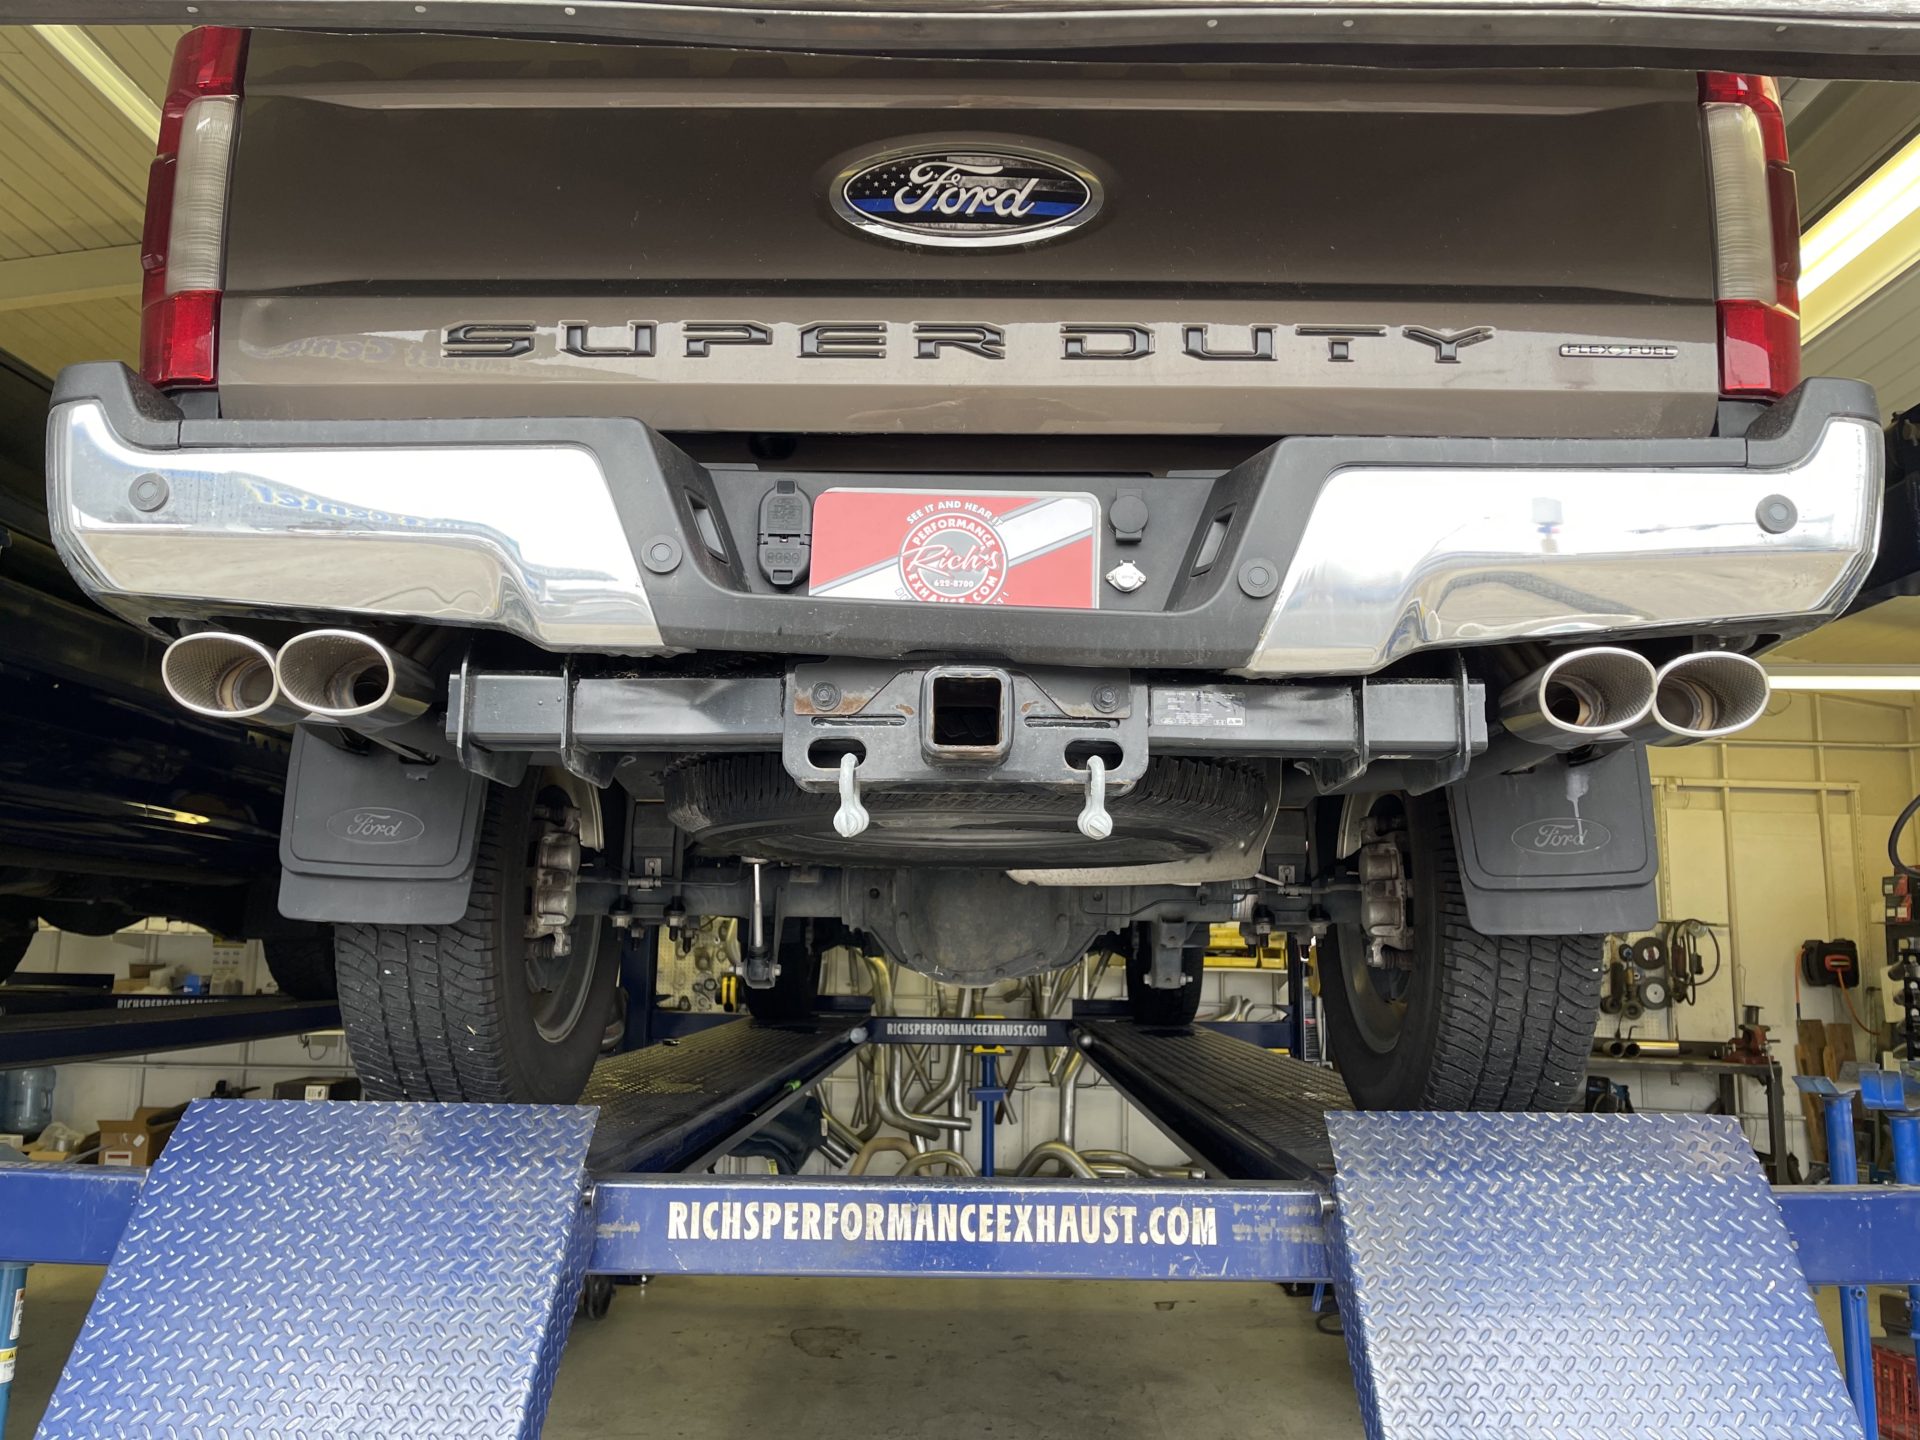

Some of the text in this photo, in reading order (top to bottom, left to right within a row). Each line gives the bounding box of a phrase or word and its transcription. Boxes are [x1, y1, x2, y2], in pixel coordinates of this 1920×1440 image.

[893, 161, 1040, 218] Ford
[441, 319, 1495, 363] SUPER DUTY
[1567, 345, 1675, 356] FLEX FUEL
[906, 500, 1003, 527] SEE IT AND HEAR IT
[912, 518, 996, 548] PERFORMANCE
[902, 544, 999, 577] Rich's
[933, 579, 975, 588] 622-8700
[346, 812, 402, 837] Ford
[1534, 824, 1588, 847] Ford
[886, 1023, 1048, 1037] RICHSPERFORMANCEEXHAUST.COM
[667, 1201, 1218, 1246] RICHSPERFORMANCEEXHAUST.COM
